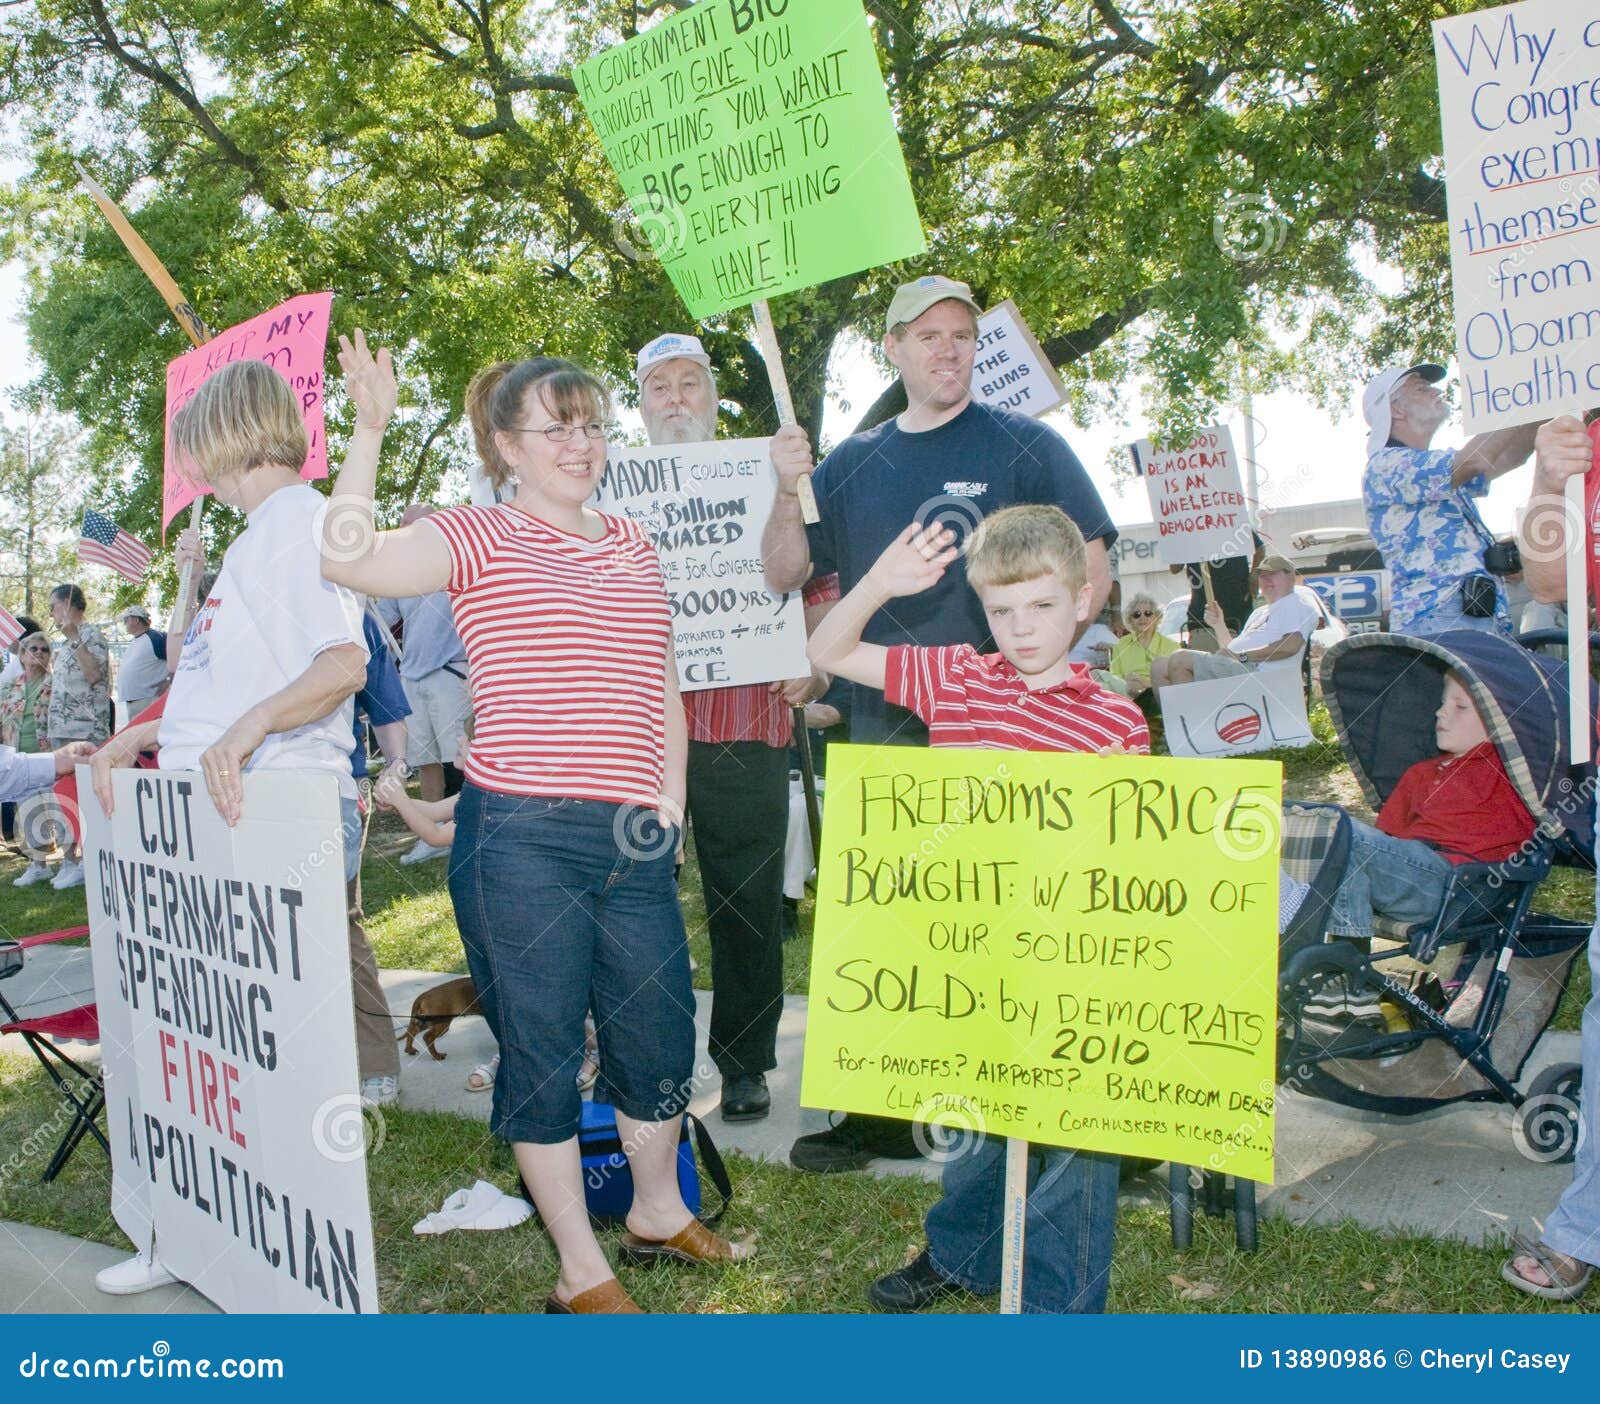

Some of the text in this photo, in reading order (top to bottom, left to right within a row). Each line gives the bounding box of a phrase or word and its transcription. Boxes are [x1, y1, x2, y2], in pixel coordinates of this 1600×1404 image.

[581, 69, 597, 100] A
[598, 5, 719, 94] GOVERNMENT
[1441, 13, 1556, 87] Why
[590, 24, 793, 140] ENOUGH TO GIVE YOU
[607, 49, 849, 177] EVERYTHING YOU WANT
[642, 112, 830, 216] BIG ENOUGH TO
[690, 165, 842, 246] EVERYTHING
[1459, 196, 1600, 253] themse
[1494, 258, 1592, 302] from
[267, 310, 314, 343] MY
[975, 326, 1006, 352] OTE
[973, 349, 1010, 375] THE
[981, 363, 1031, 397] BUMS
[1466, 354, 1577, 419] Health
[596, 456, 762, 502] MADOFF COULD GET
[1147, 451, 1228, 477] DEMOCRAT
[1164, 473, 1209, 495] IS AN
[1158, 512, 1238, 537] DEMOCRAT
[1159, 491, 1245, 517] UNELECTED
[135, 777, 196, 862] CUT
[1089, 777, 1274, 846] PRICE
[97, 847, 304, 983] GOVERNMENT
[1080, 867, 1188, 917] BLOOD
[1209, 881, 1268, 914] OF
[928, 921, 1173, 971] OUR SOLDIERS
[115, 930, 279, 1072] SPENDING
[998, 978, 1040, 1037] by
[1057, 993, 1266, 1048] DEMOCRATS
[1050, 1028, 1150, 1067] 2010
[158, 1028, 248, 1151] FIRE
[1105, 1073, 1222, 1111] BACKROOM
[127, 1096, 363, 1315] A POLITICIAN
